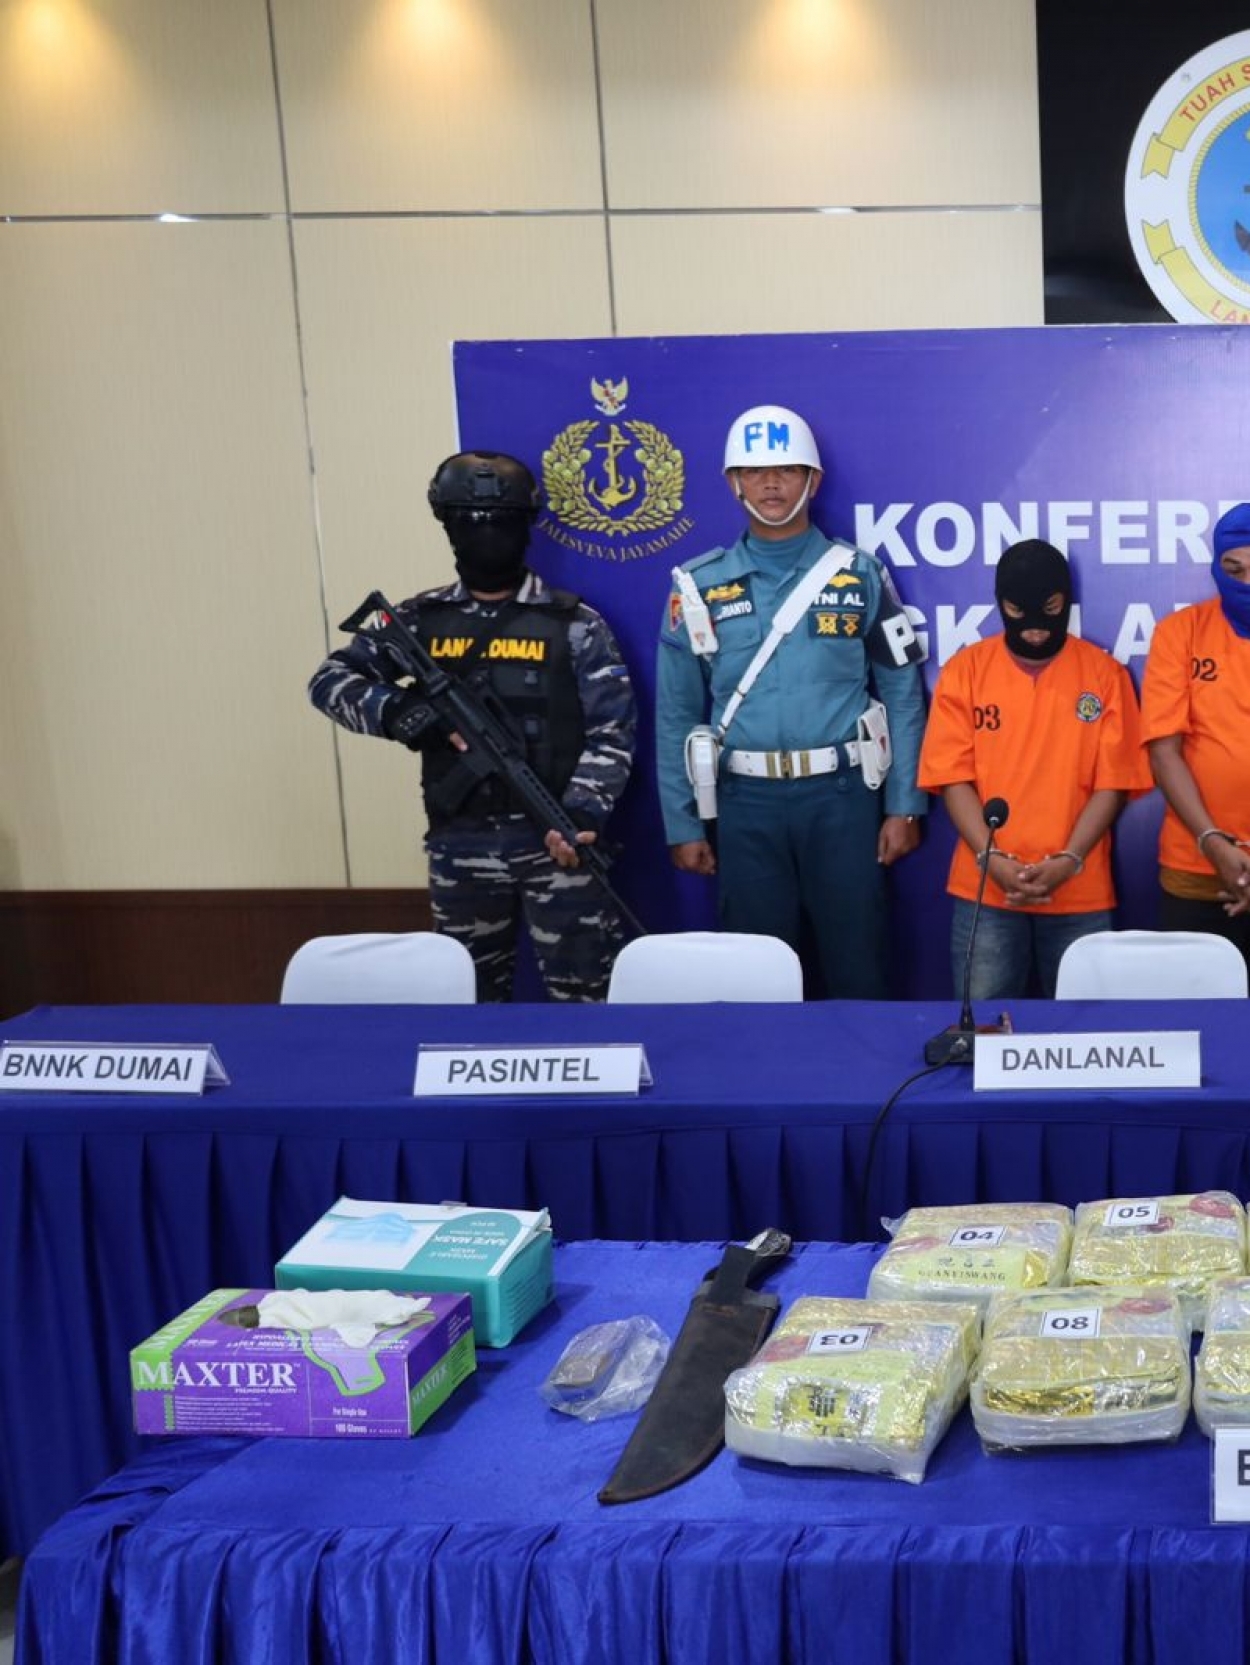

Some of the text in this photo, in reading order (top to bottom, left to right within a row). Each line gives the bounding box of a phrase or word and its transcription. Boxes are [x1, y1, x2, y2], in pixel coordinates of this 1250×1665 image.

[1179, 73, 1236, 123] TUAH
[843, 592, 865, 606] AL
[488, 638, 545, 661] DUMAI
[1190, 657, 1218, 682] 02
[972, 705, 1001, 731] 03
[3, 1054, 193, 1081] BNNK DUMAI
[447, 1058, 601, 1084] PASINTEL
[1001, 1045, 1165, 1072] DANLANAL
[1118, 1206, 1150, 1218] 05
[960, 1230, 995, 1241] 04
[1050, 1316, 1089, 1330] 08
[136, 1361, 298, 1388] MAXTER
